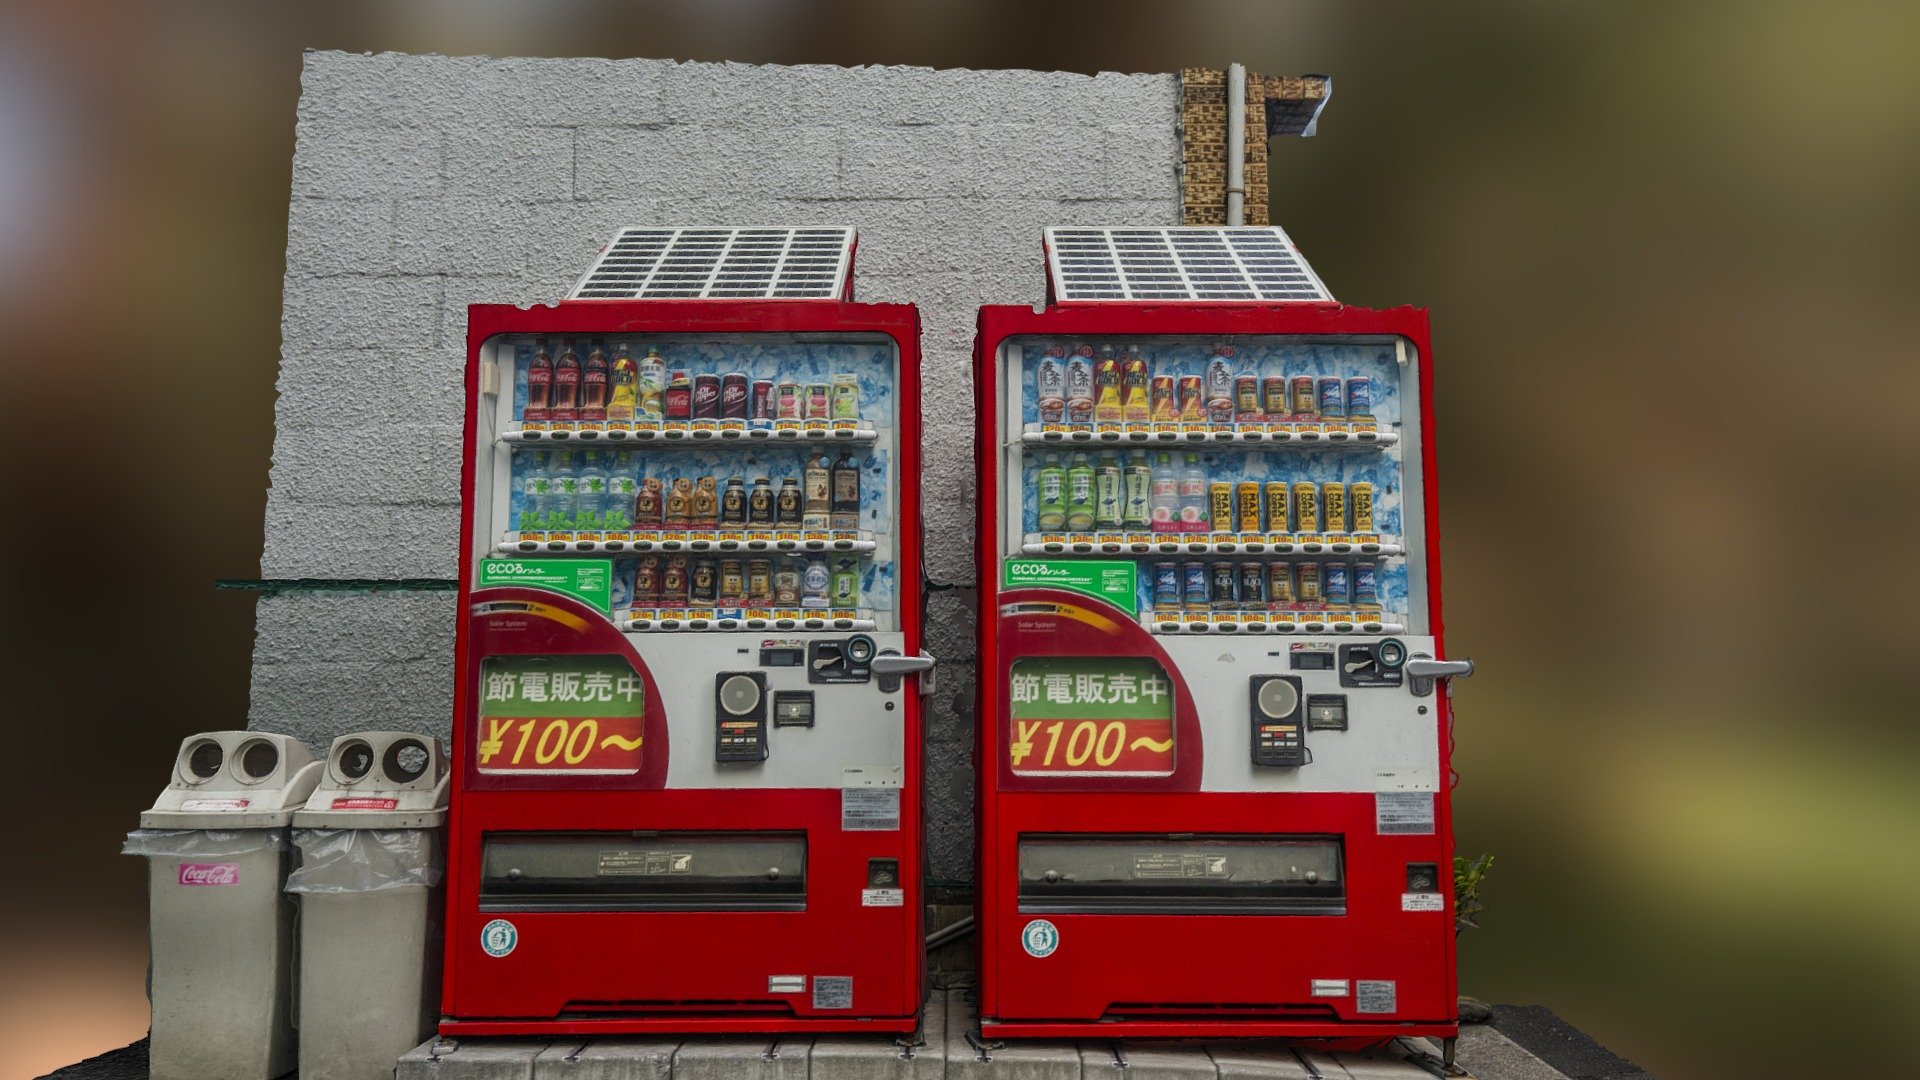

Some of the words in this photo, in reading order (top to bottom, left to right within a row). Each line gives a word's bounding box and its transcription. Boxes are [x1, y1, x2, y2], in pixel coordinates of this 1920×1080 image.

[1221, 493, 1229, 518] MAX
[1277, 493, 1285, 517] MAX
[1306, 493, 1314, 517] MAX
[1334, 493, 1343, 518] MAX
[506, 620, 527, 628] System
[486, 671, 642, 702] 節電販売中
[1011, 672, 1168, 704] 節電販売中
